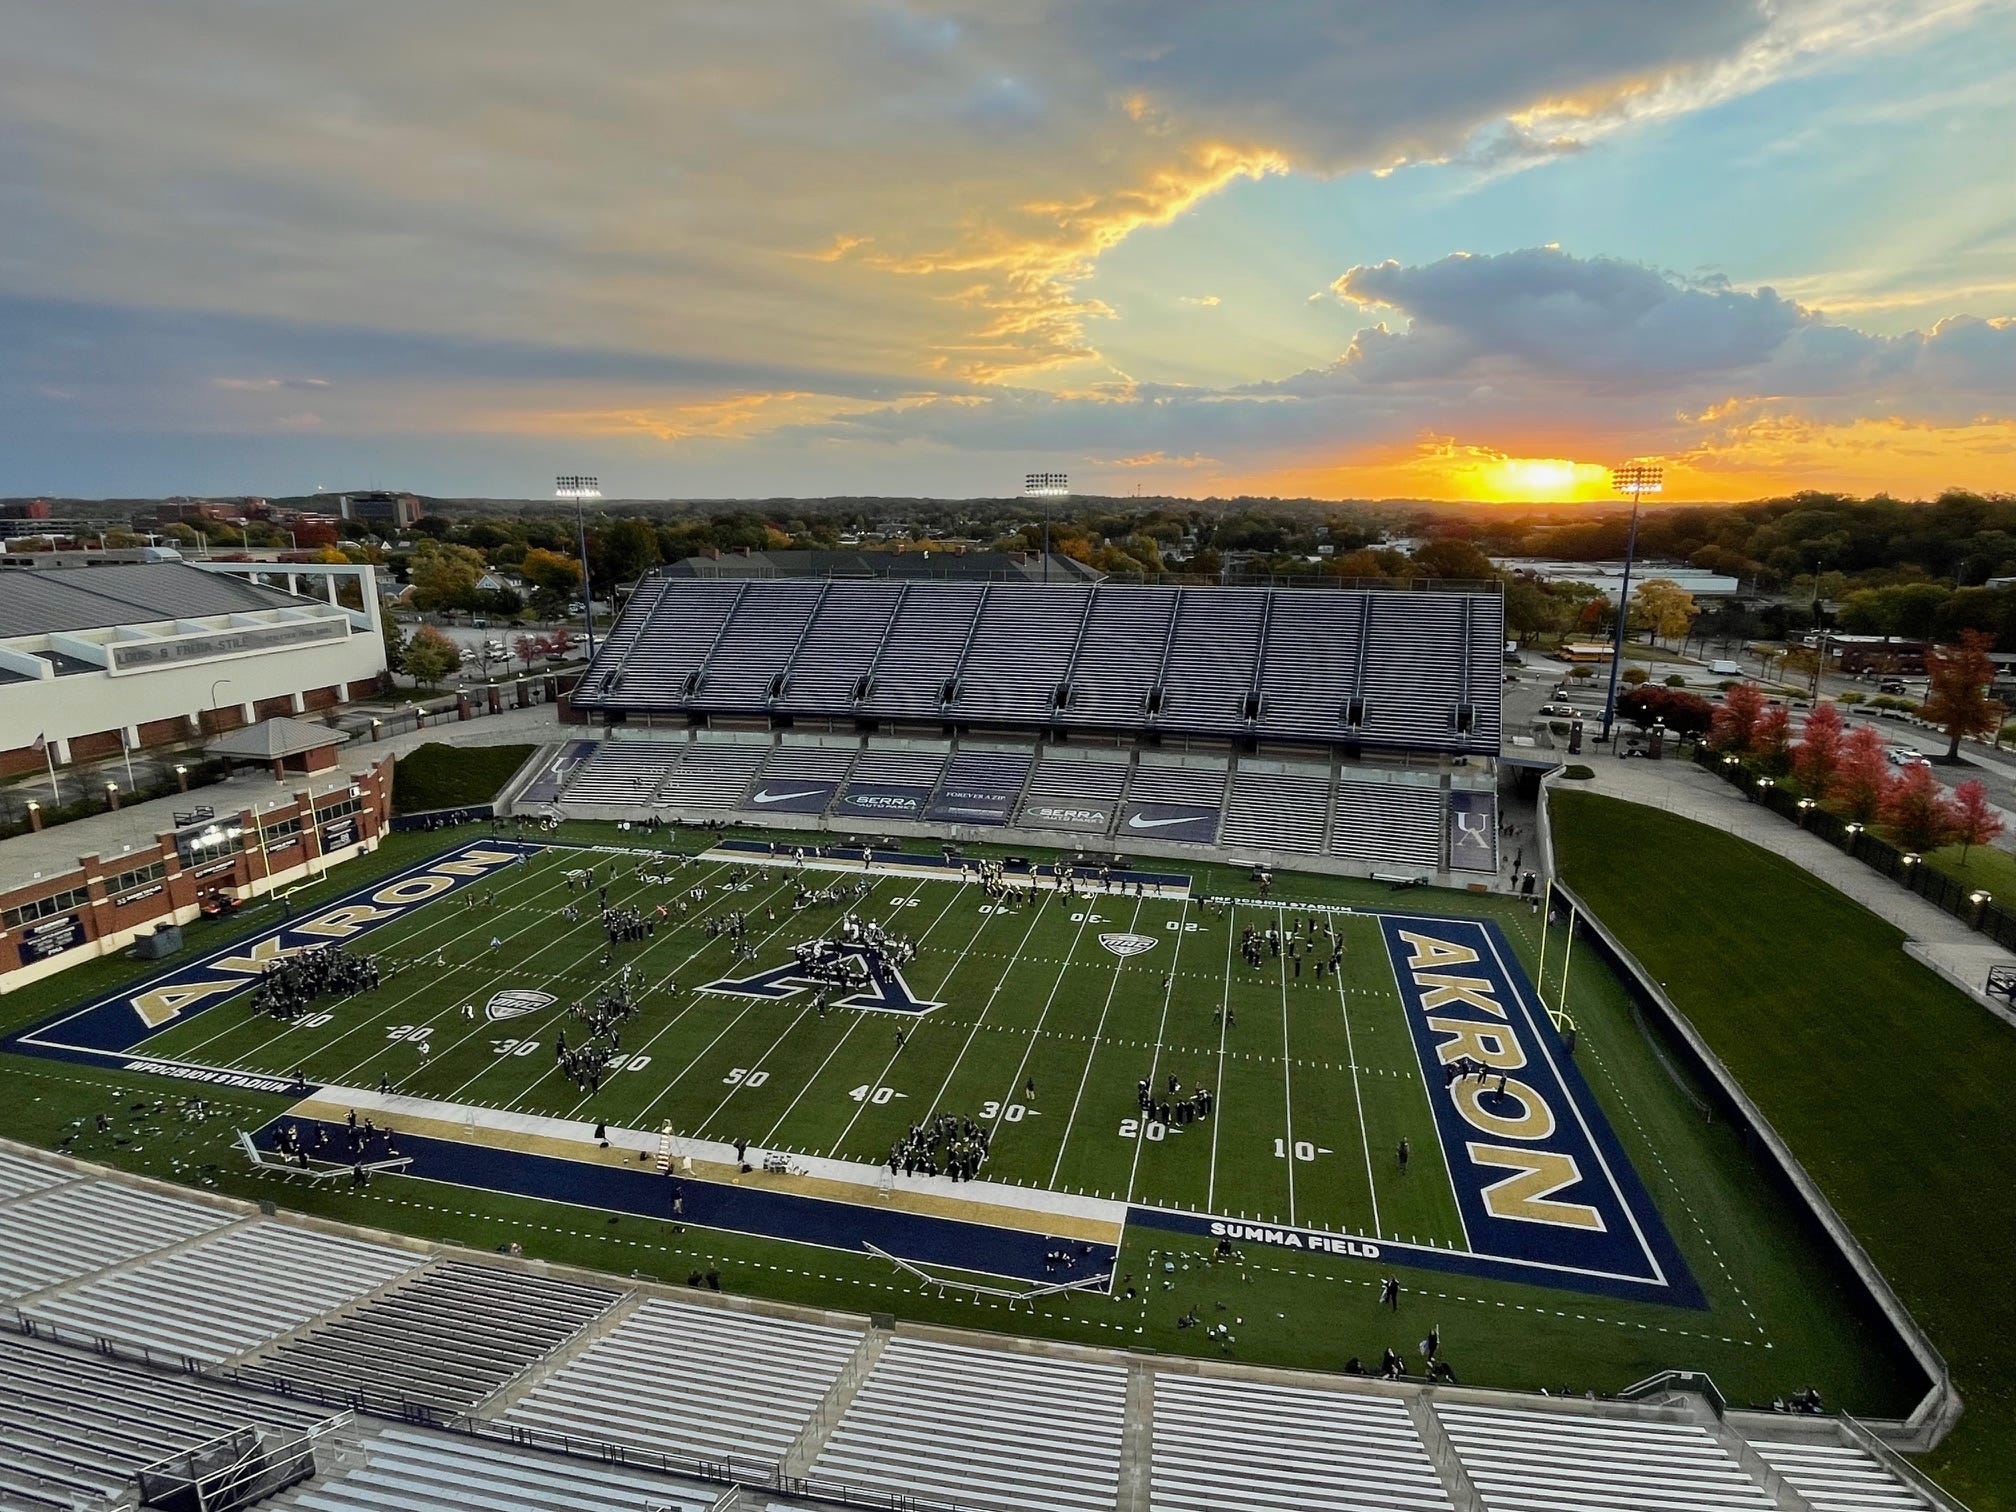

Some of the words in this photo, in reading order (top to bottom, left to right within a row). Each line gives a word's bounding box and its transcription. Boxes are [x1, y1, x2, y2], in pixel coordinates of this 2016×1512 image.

[856, 796, 917, 806] SERRA
[1040, 808, 1105, 819] SERRA
[129, 849, 520, 1028] AKRON
[291, 1012, 334, 1028] 10
[385, 1025, 434, 1041] 20
[493, 1039, 540, 1056] 30
[607, 1053, 651, 1071] 40
[123, 1060, 215, 1082] INFOCISION
[212, 1074, 293, 1093] STADIUM
[722, 1068, 769, 1087] 50
[1398, 929, 1607, 1233] AKRON
[848, 1085, 894, 1104] 40
[979, 1101, 1025, 1122] 30
[1118, 1118, 1165, 1142] 20
[1274, 1138, 1315, 1162] 10
[1210, 1222, 1303, 1248] SUMMA
[1308, 1236, 1380, 1259] FIELD
